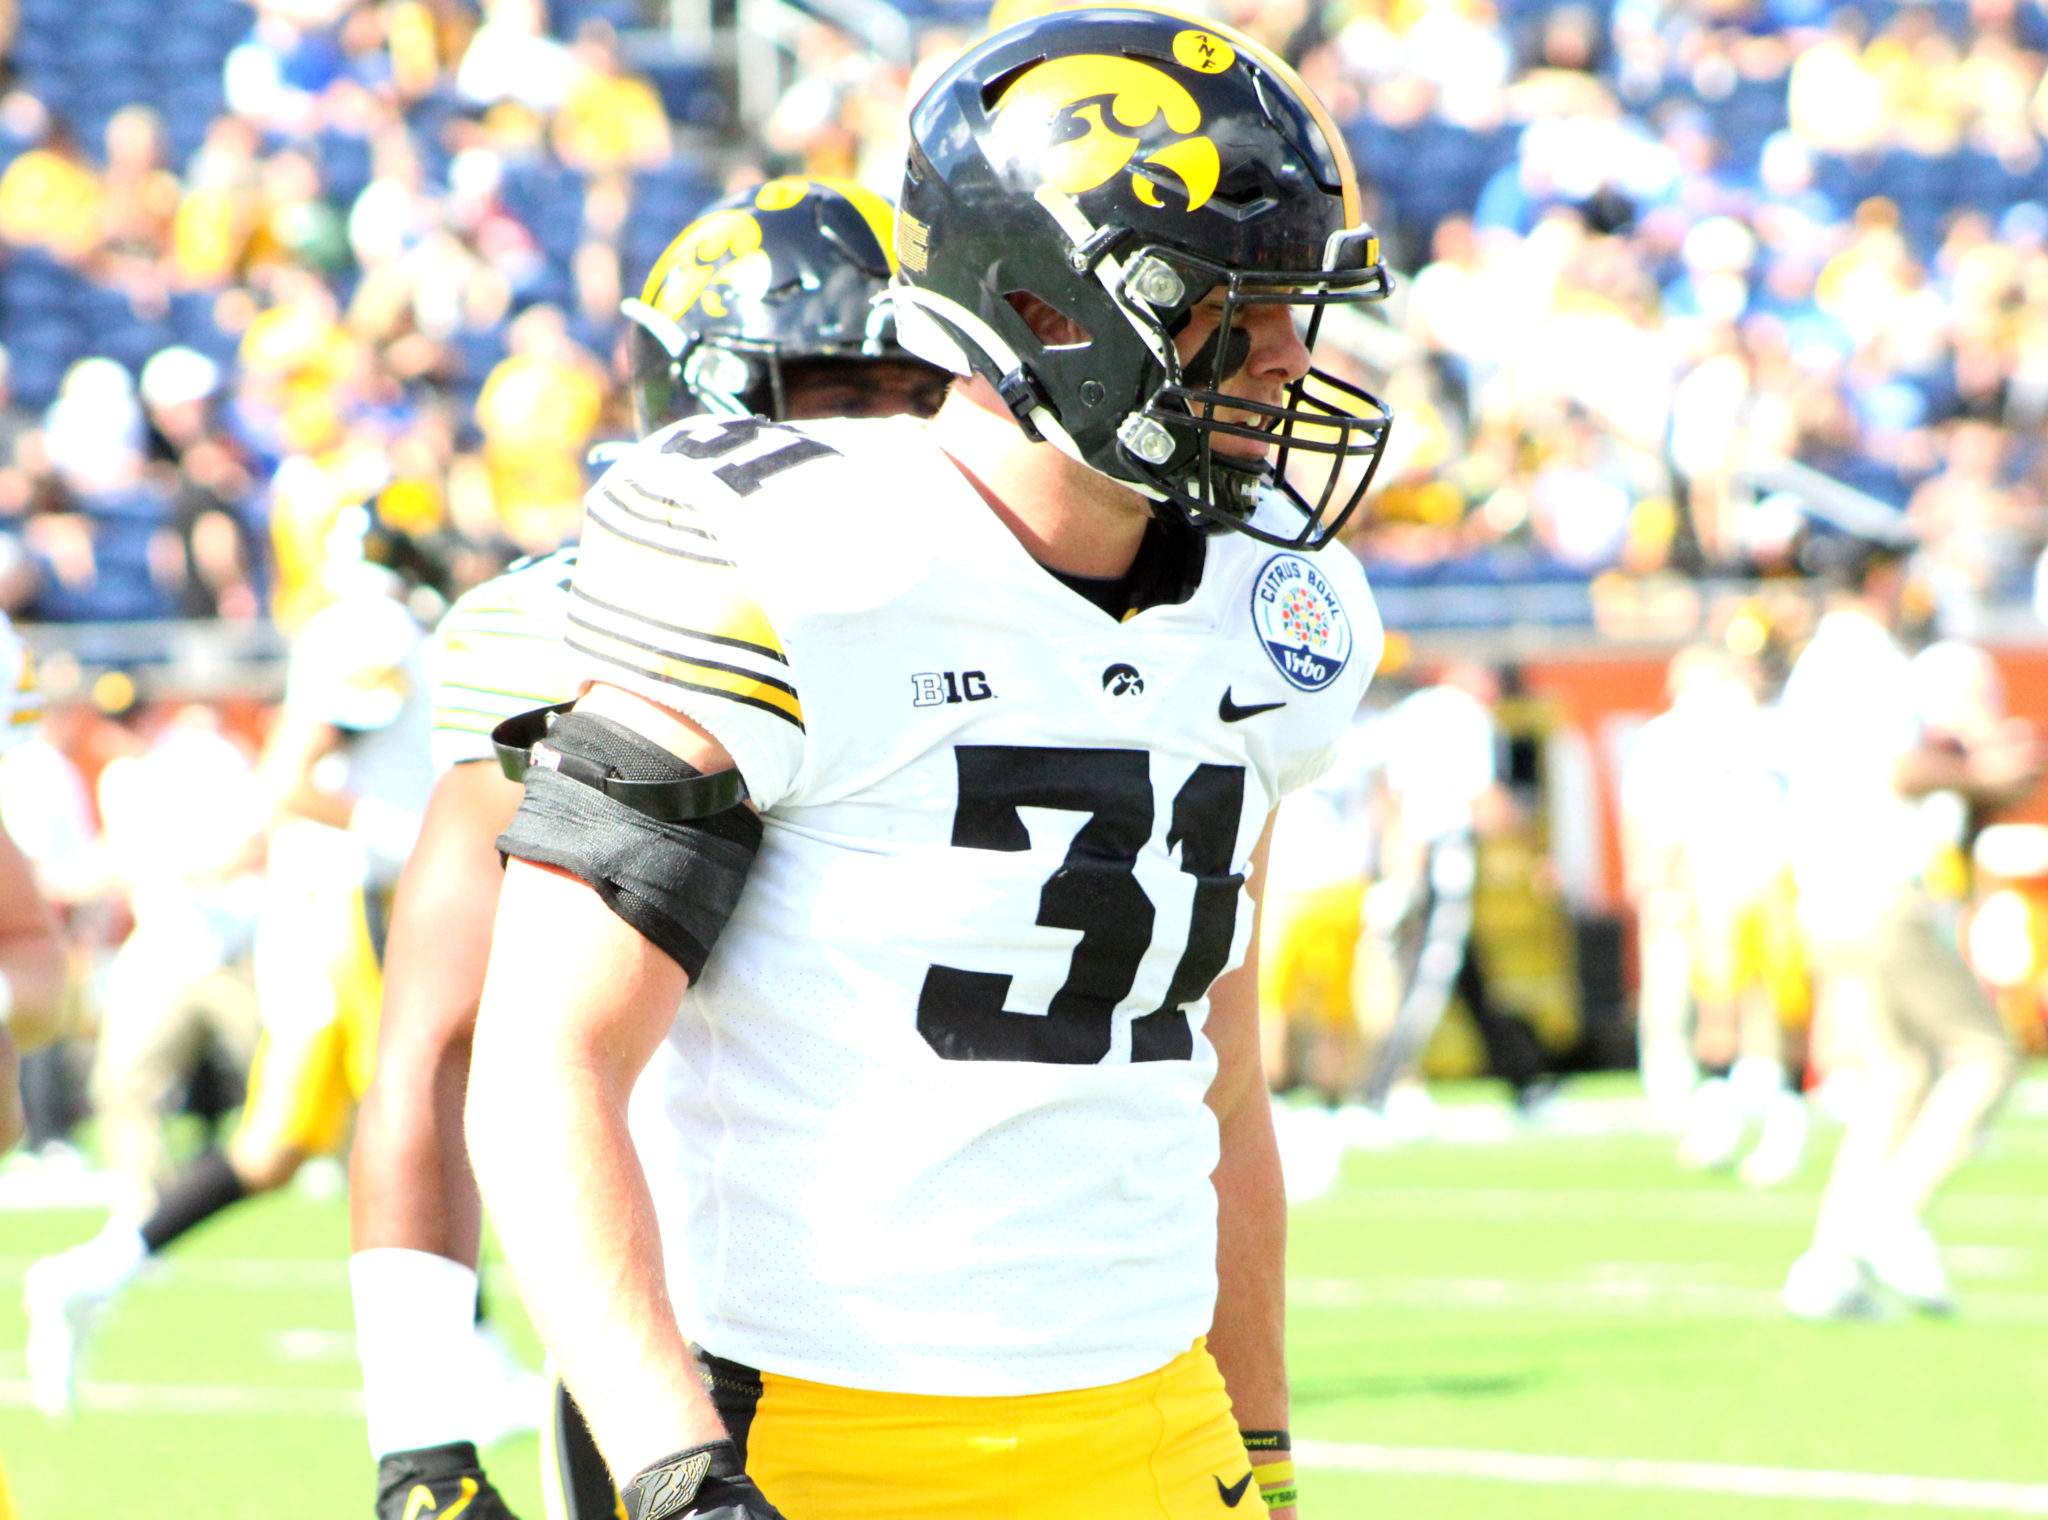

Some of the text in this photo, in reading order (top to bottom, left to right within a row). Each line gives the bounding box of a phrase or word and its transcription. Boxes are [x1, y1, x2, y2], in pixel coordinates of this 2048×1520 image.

[1261, 561, 1340, 621] CITRUS BOWL
[1283, 649, 1326, 681] Vrbo
[916, 745, 1246, 1065] 31
[1244, 1435, 1279, 1447] ower!
